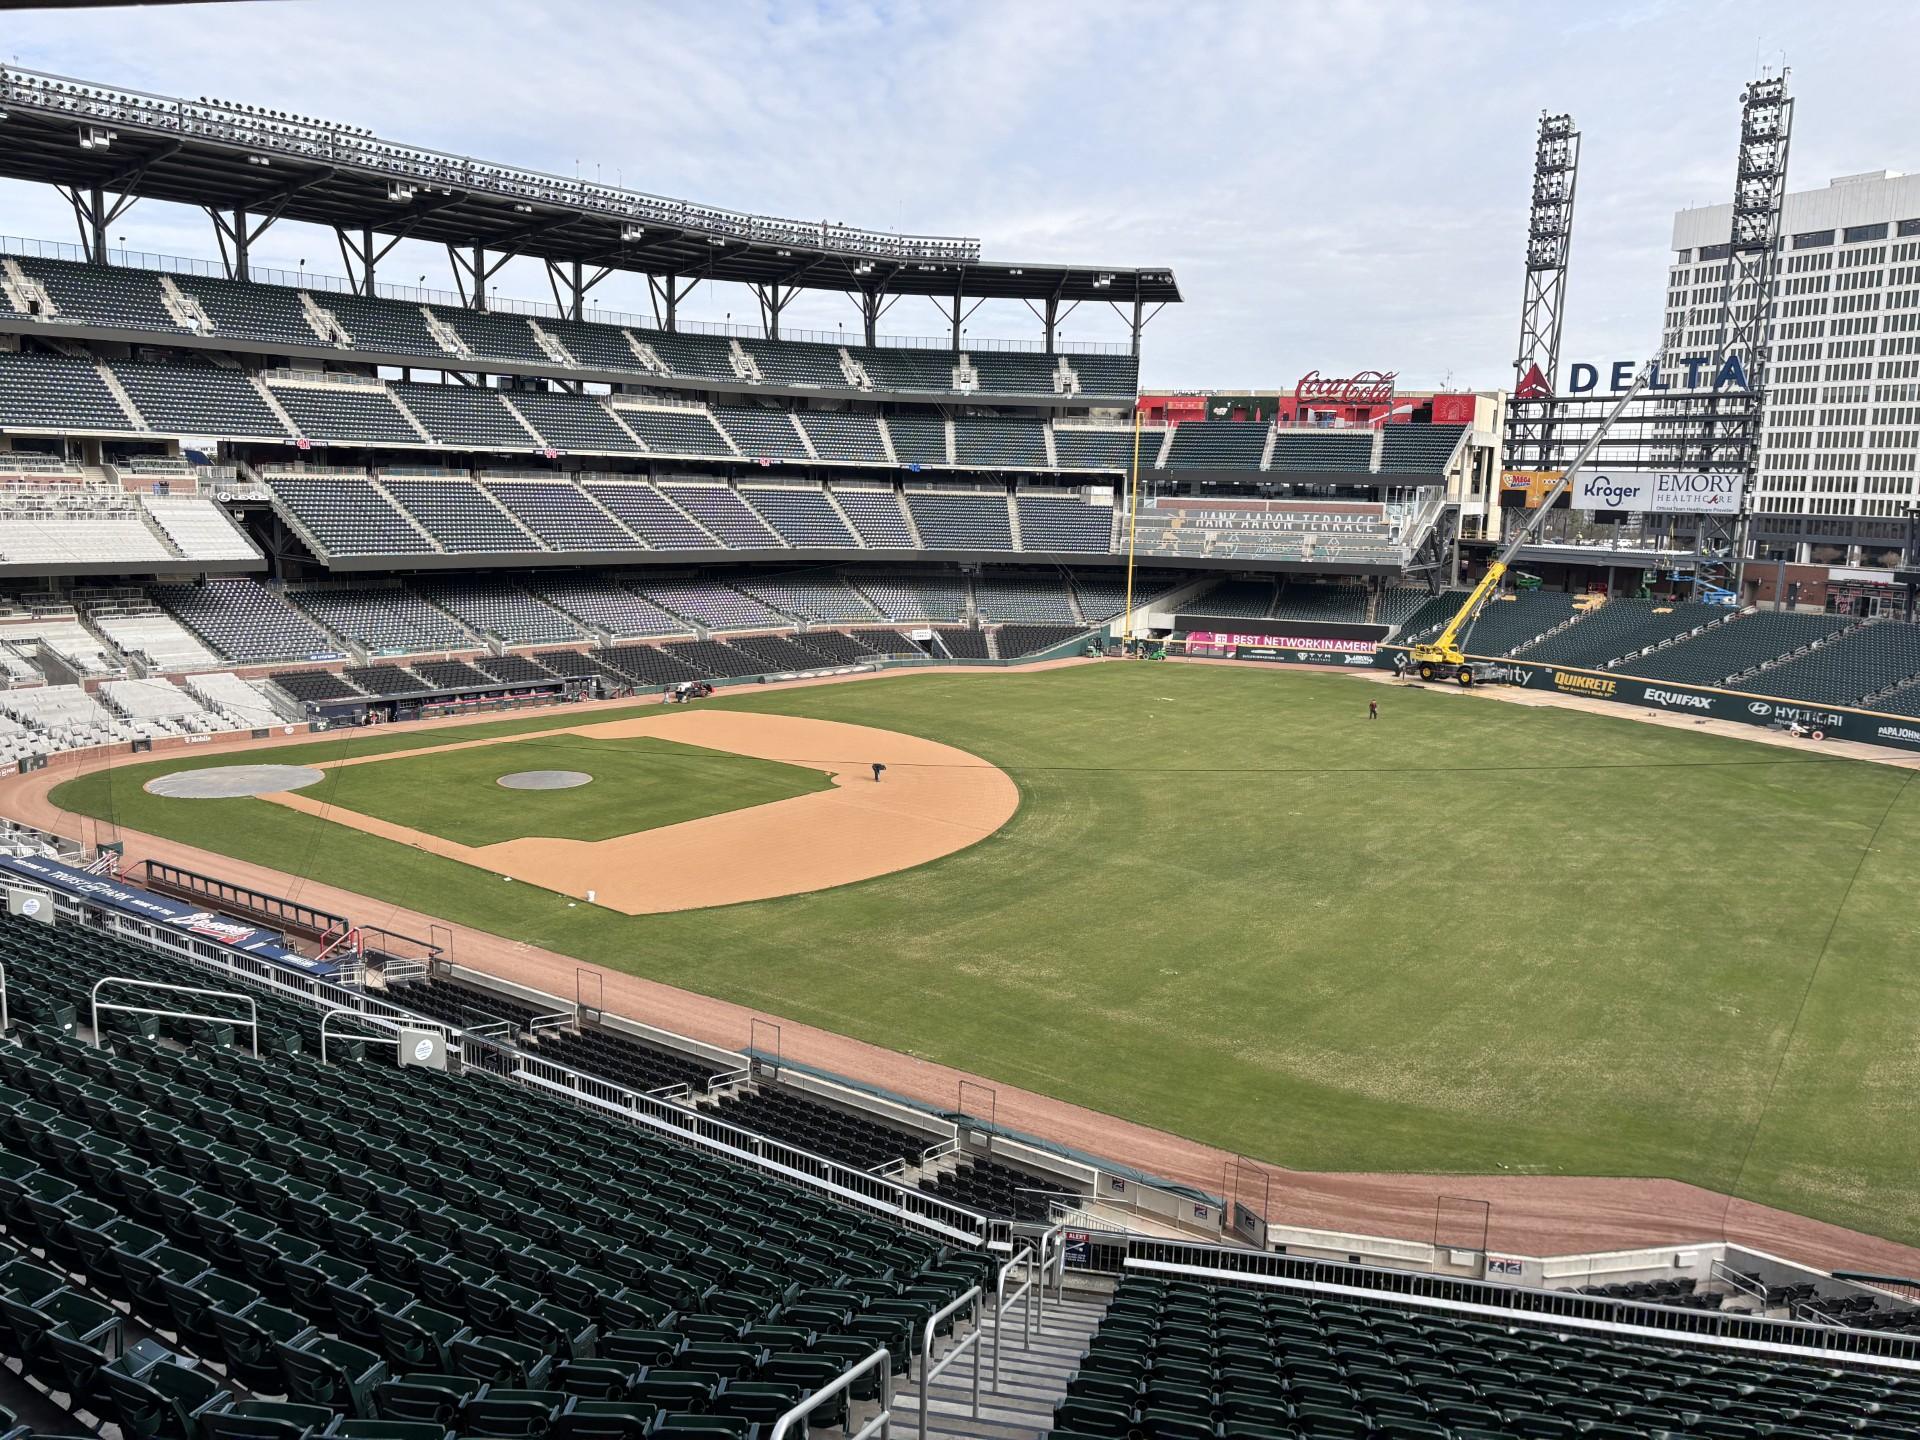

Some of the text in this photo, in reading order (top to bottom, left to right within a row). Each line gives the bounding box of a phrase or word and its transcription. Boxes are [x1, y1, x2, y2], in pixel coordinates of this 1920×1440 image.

[1569, 355, 1750, 393] DELTA
[1584, 476, 1640, 507] Kroger
[1657, 474, 1739, 493] EMORY
[1657, 494, 1733, 504] HEALTHCARE
[1195, 511, 1374, 533] HANK AARON TERRACE
[1233, 634, 1261, 645] BEST
[1554, 671, 1616, 692] QUIKRETE
[1644, 687, 1712, 709] EQUIFAX
[191, 735, 211, 743] Mobile
[1878, 726, 1898, 737] PAPA
[48, 870, 90, 889] TRUIST
[164, 912, 257, 935] Braves
